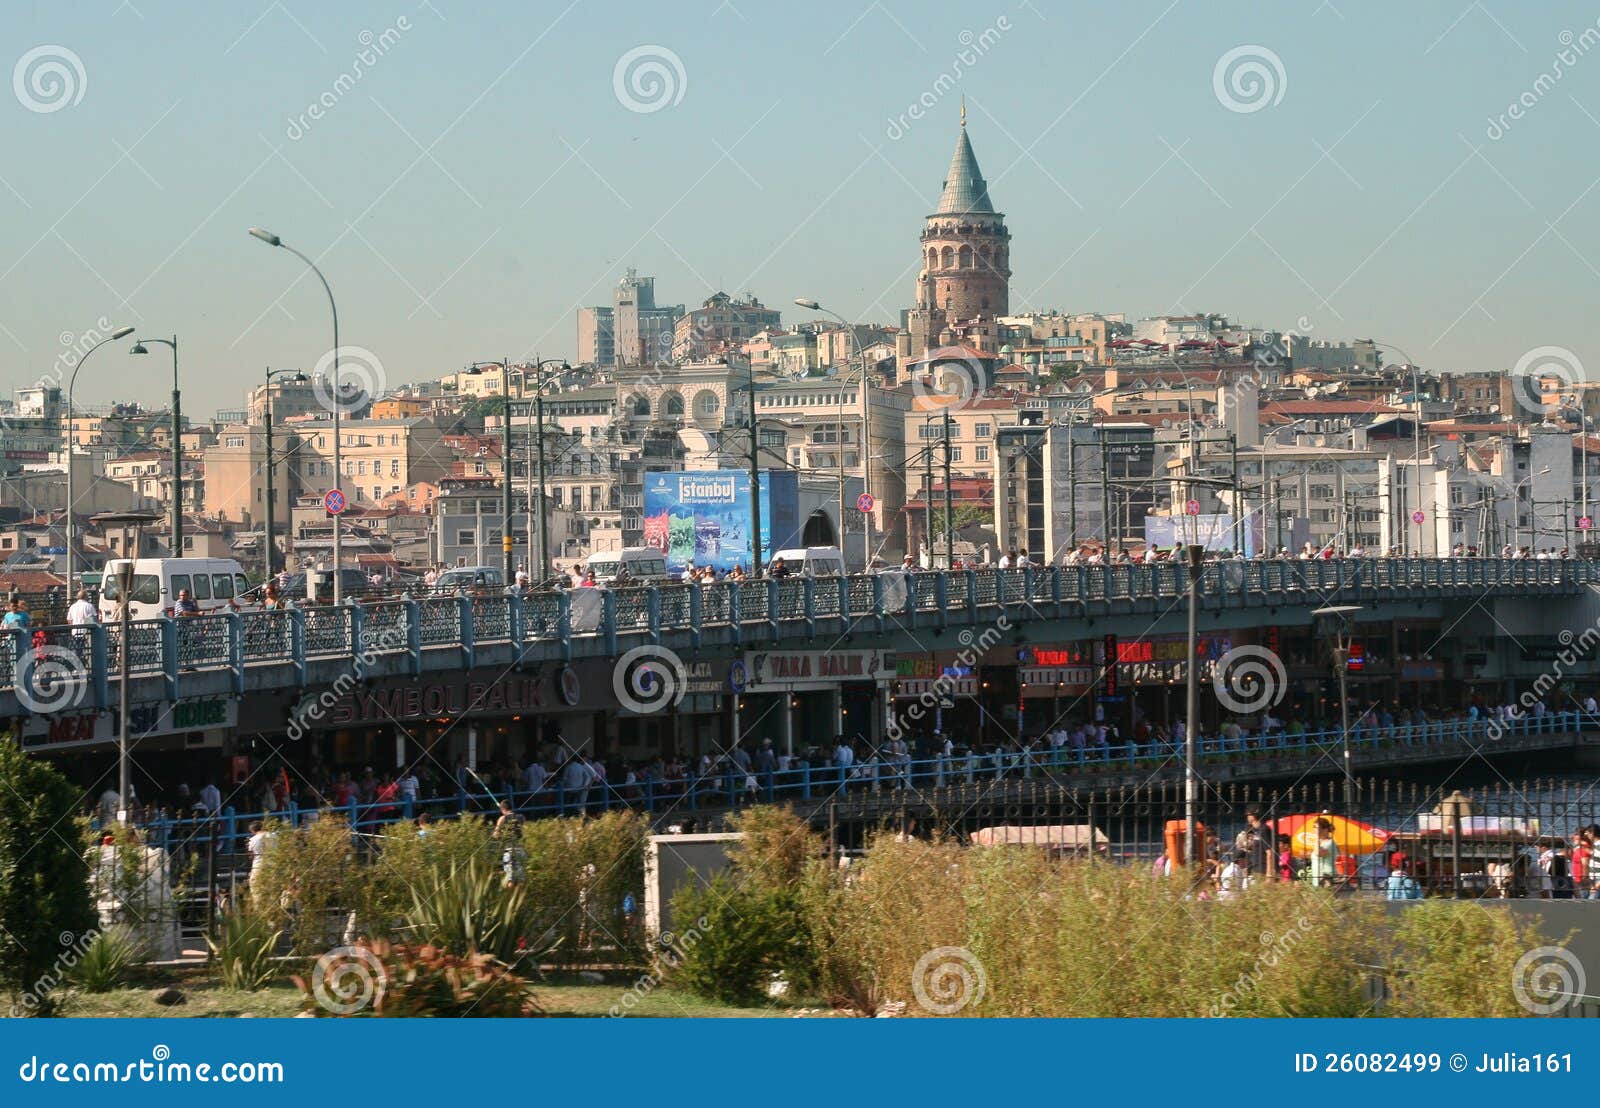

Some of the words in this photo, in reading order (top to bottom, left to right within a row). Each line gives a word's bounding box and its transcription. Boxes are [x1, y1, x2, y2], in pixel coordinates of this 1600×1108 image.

[770, 655, 811, 677] YAKA
[49, 714, 97, 744] MEAT
[113, 705, 158, 737] SH
[173, 699, 227, 729] HOUSE
[331, 683, 460, 725] SYMBOL
[468, 678, 547, 712] BALIK
